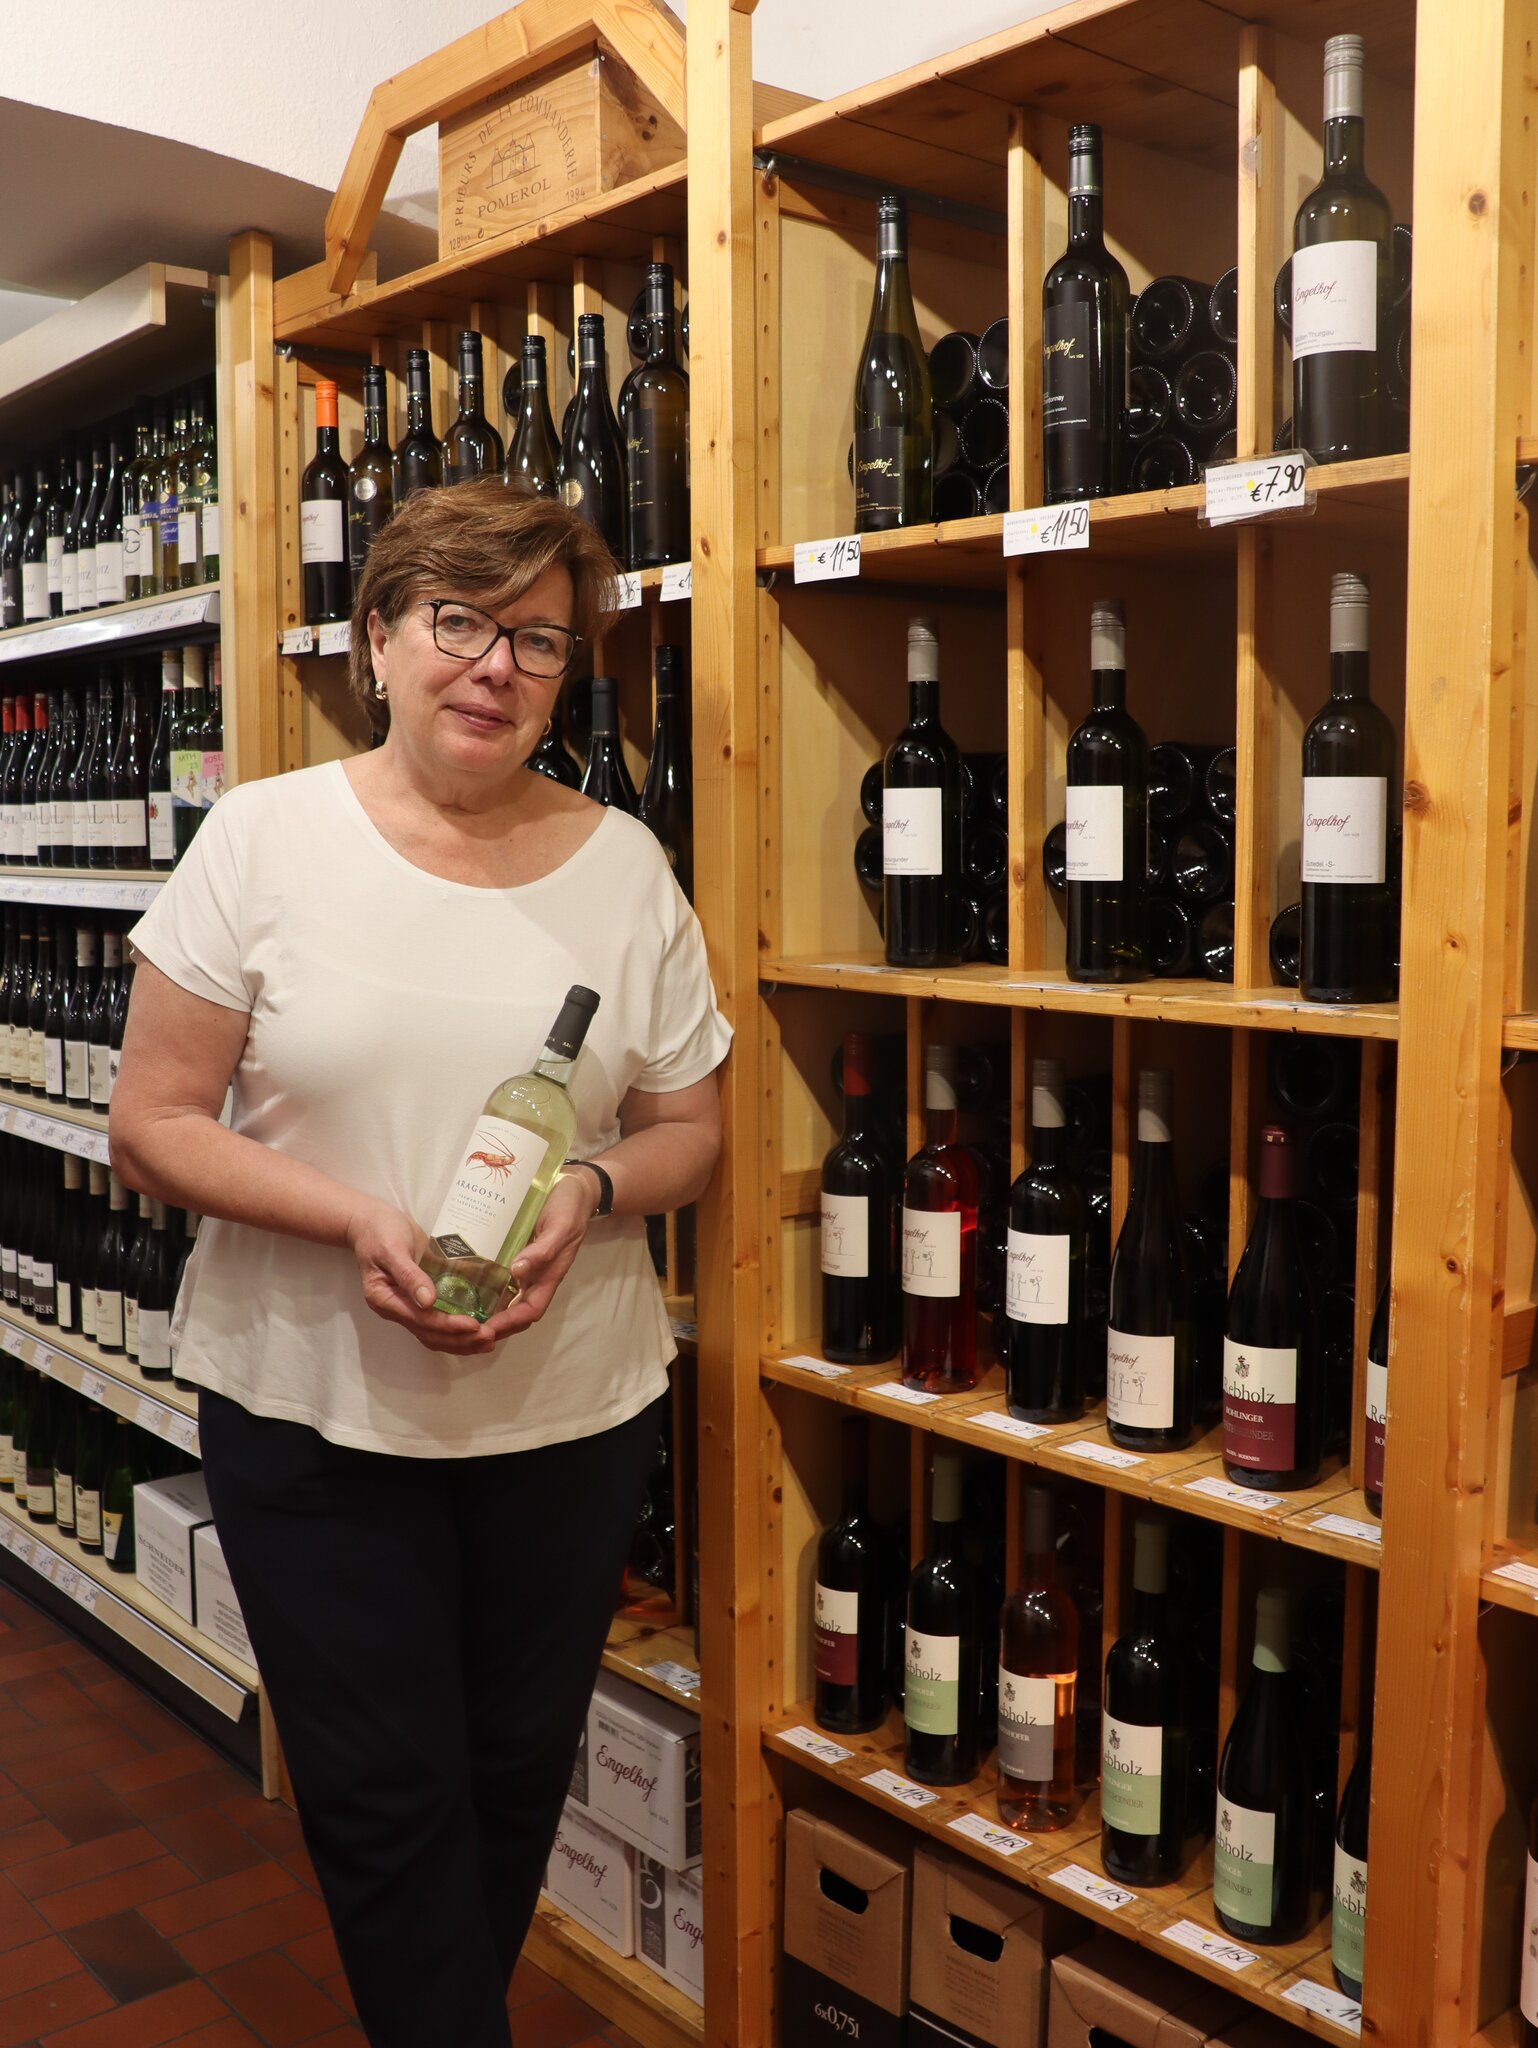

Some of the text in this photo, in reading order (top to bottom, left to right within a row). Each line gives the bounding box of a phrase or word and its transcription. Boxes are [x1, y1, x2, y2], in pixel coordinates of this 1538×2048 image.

[455, 151, 477, 228] PRIEURS
[478, 120, 494, 144] DE
[520, 95, 578, 181] COMMANDERIE
[477, 178, 552, 218] POMEROL
[1295, 281, 1338, 305] Engelhof
[1306, 813, 1351, 833] Engelhof
[456, 1179, 507, 1205] ARAGOSTA
[903, 1229, 929, 1244] ngelhof
[1008, 1252, 1037, 1269] ngelhof
[1223, 1376, 1276, 1405] Rebholz
[1370, 1404, 1387, 1425] Re
[138, 1533, 186, 1578] SCHNEIDER
[906, 1660, 942, 1682] ebholz
[1000, 1702, 1038, 1727] ebholz
[596, 1745, 659, 1803] Engelhof
[1104, 1750, 1143, 1776] ebholz
[554, 1831, 609, 1889] Engelhof
[1217, 1832, 1254, 1863] ebholz
[1335, 1883, 1367, 1918] Rebh
[673, 1907, 704, 1950] Enge
[814, 2002, 860, 2039] 6x0,75l
